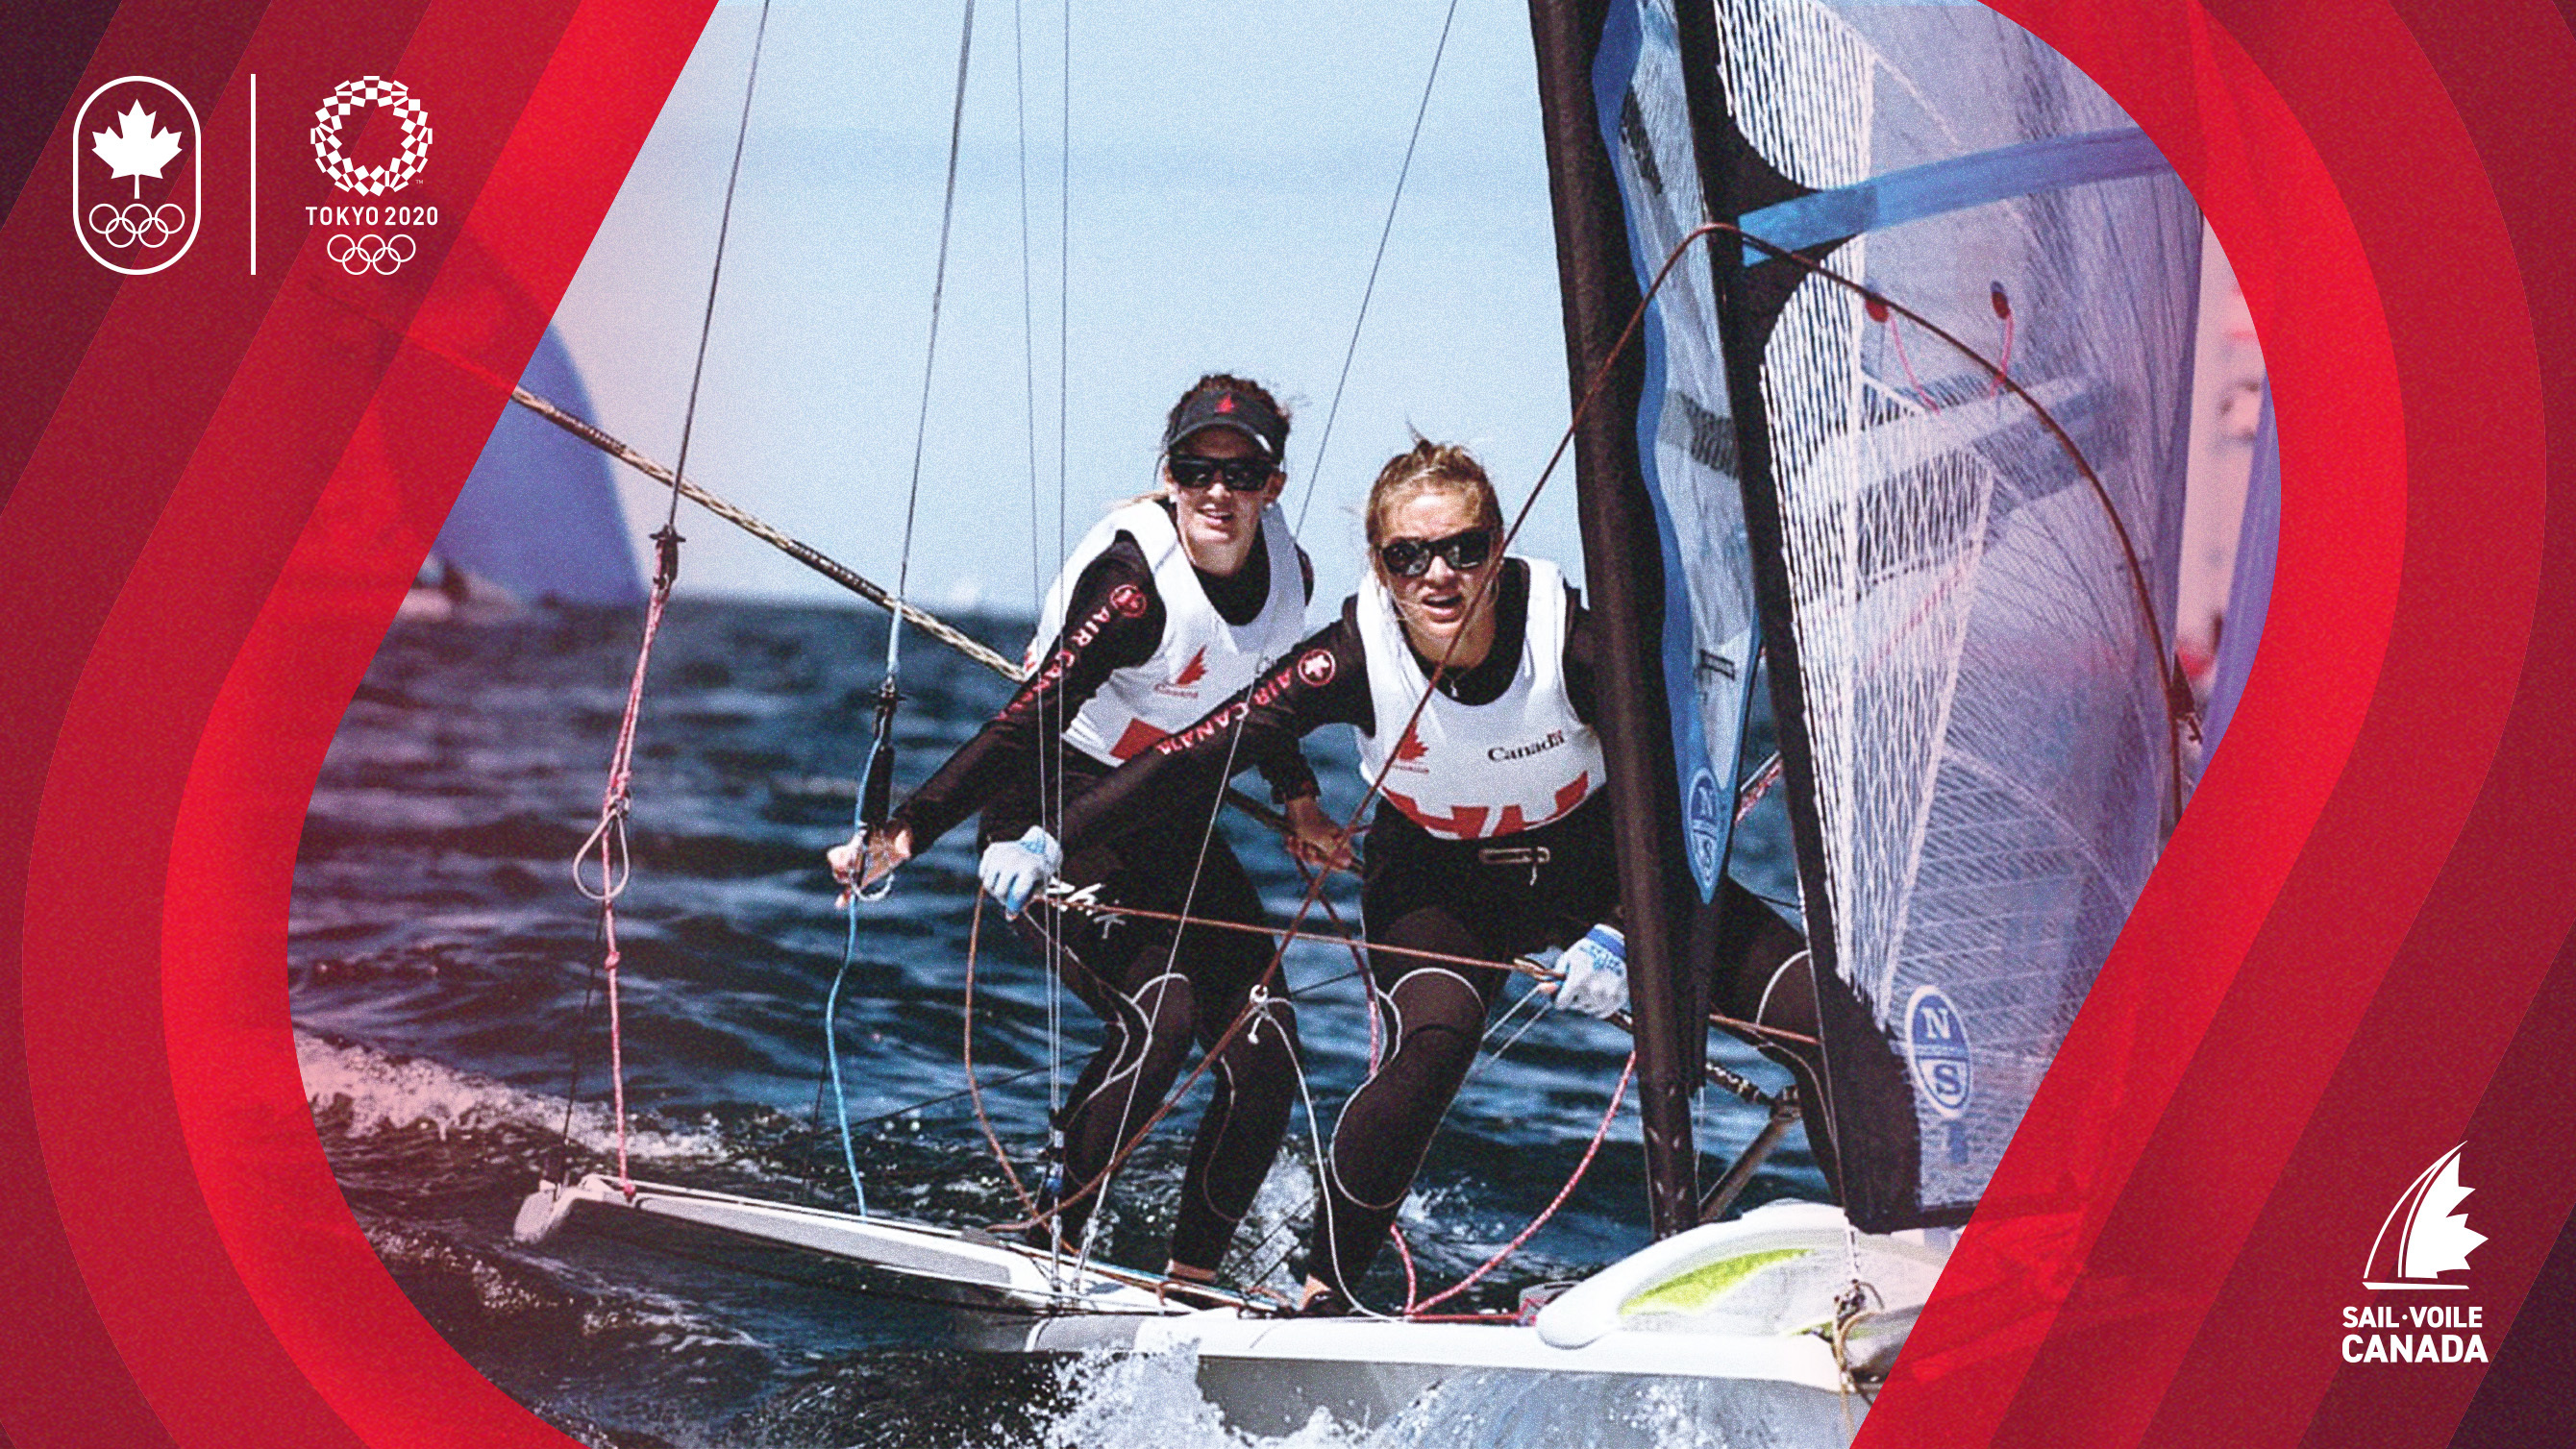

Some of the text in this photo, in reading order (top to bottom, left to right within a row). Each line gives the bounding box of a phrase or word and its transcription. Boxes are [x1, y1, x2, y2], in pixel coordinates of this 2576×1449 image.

[1071, 606, 1111, 648] AIR
[1252, 666, 1293, 706] AIR
[1488, 730, 1565, 762] Canada
[1920, 1007, 1951, 1040] N
[1933, 1063, 1962, 1095] S
